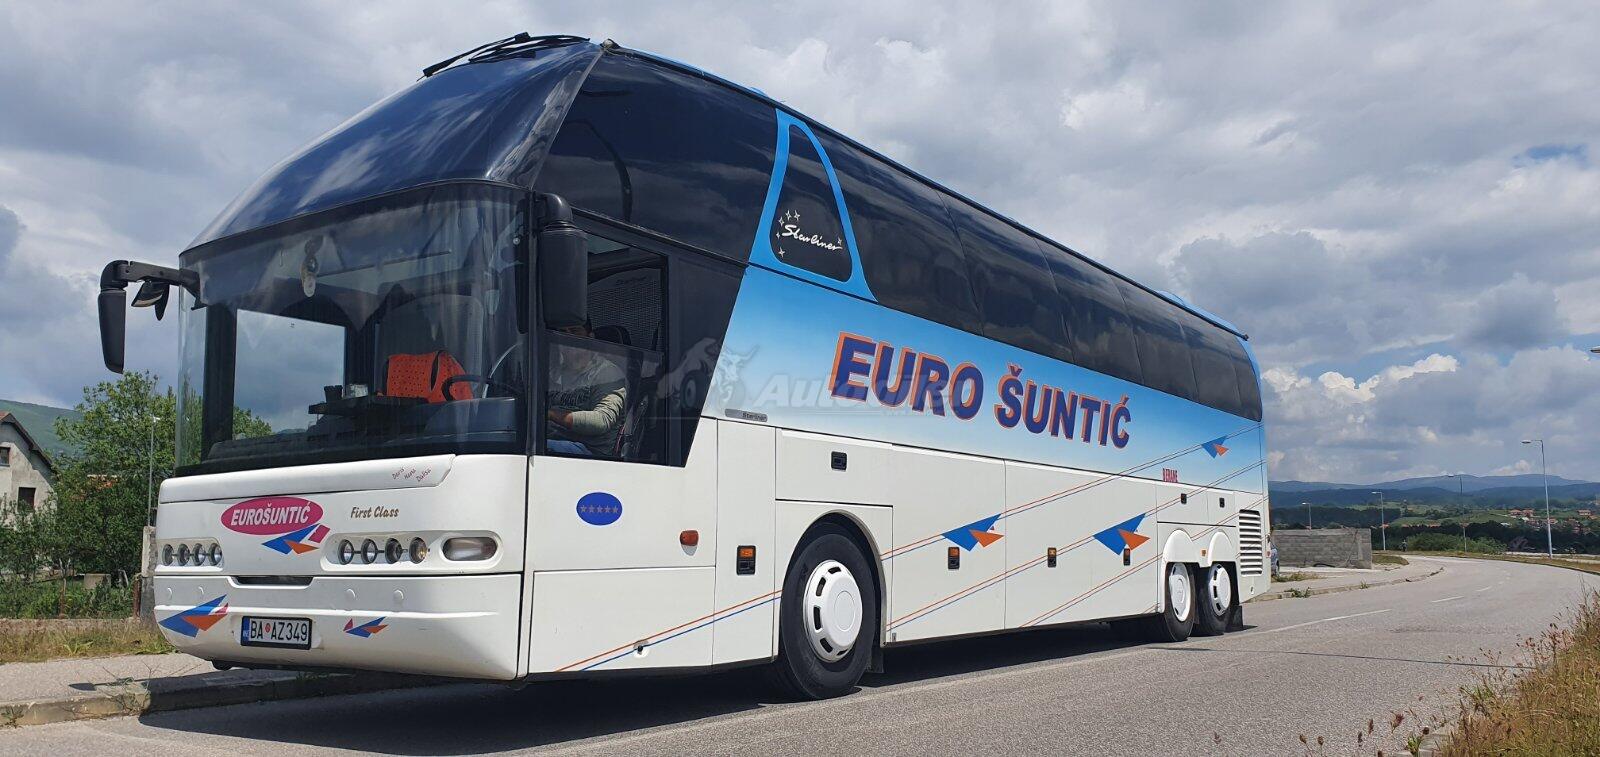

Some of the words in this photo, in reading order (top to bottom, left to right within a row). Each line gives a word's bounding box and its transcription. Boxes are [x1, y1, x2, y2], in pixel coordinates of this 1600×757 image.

[781, 224, 843, 251] Starliner
[827, 331, 985, 421] EURO
[994, 362, 1132, 449] ŠUNTIĆ
[231, 502, 311, 526] EUROŠUNTIĆ
[350, 506, 373, 520] First
[374, 506, 400, 519] Class
[250, 620, 264, 639] BA
[270, 621, 308, 641] AZ349
